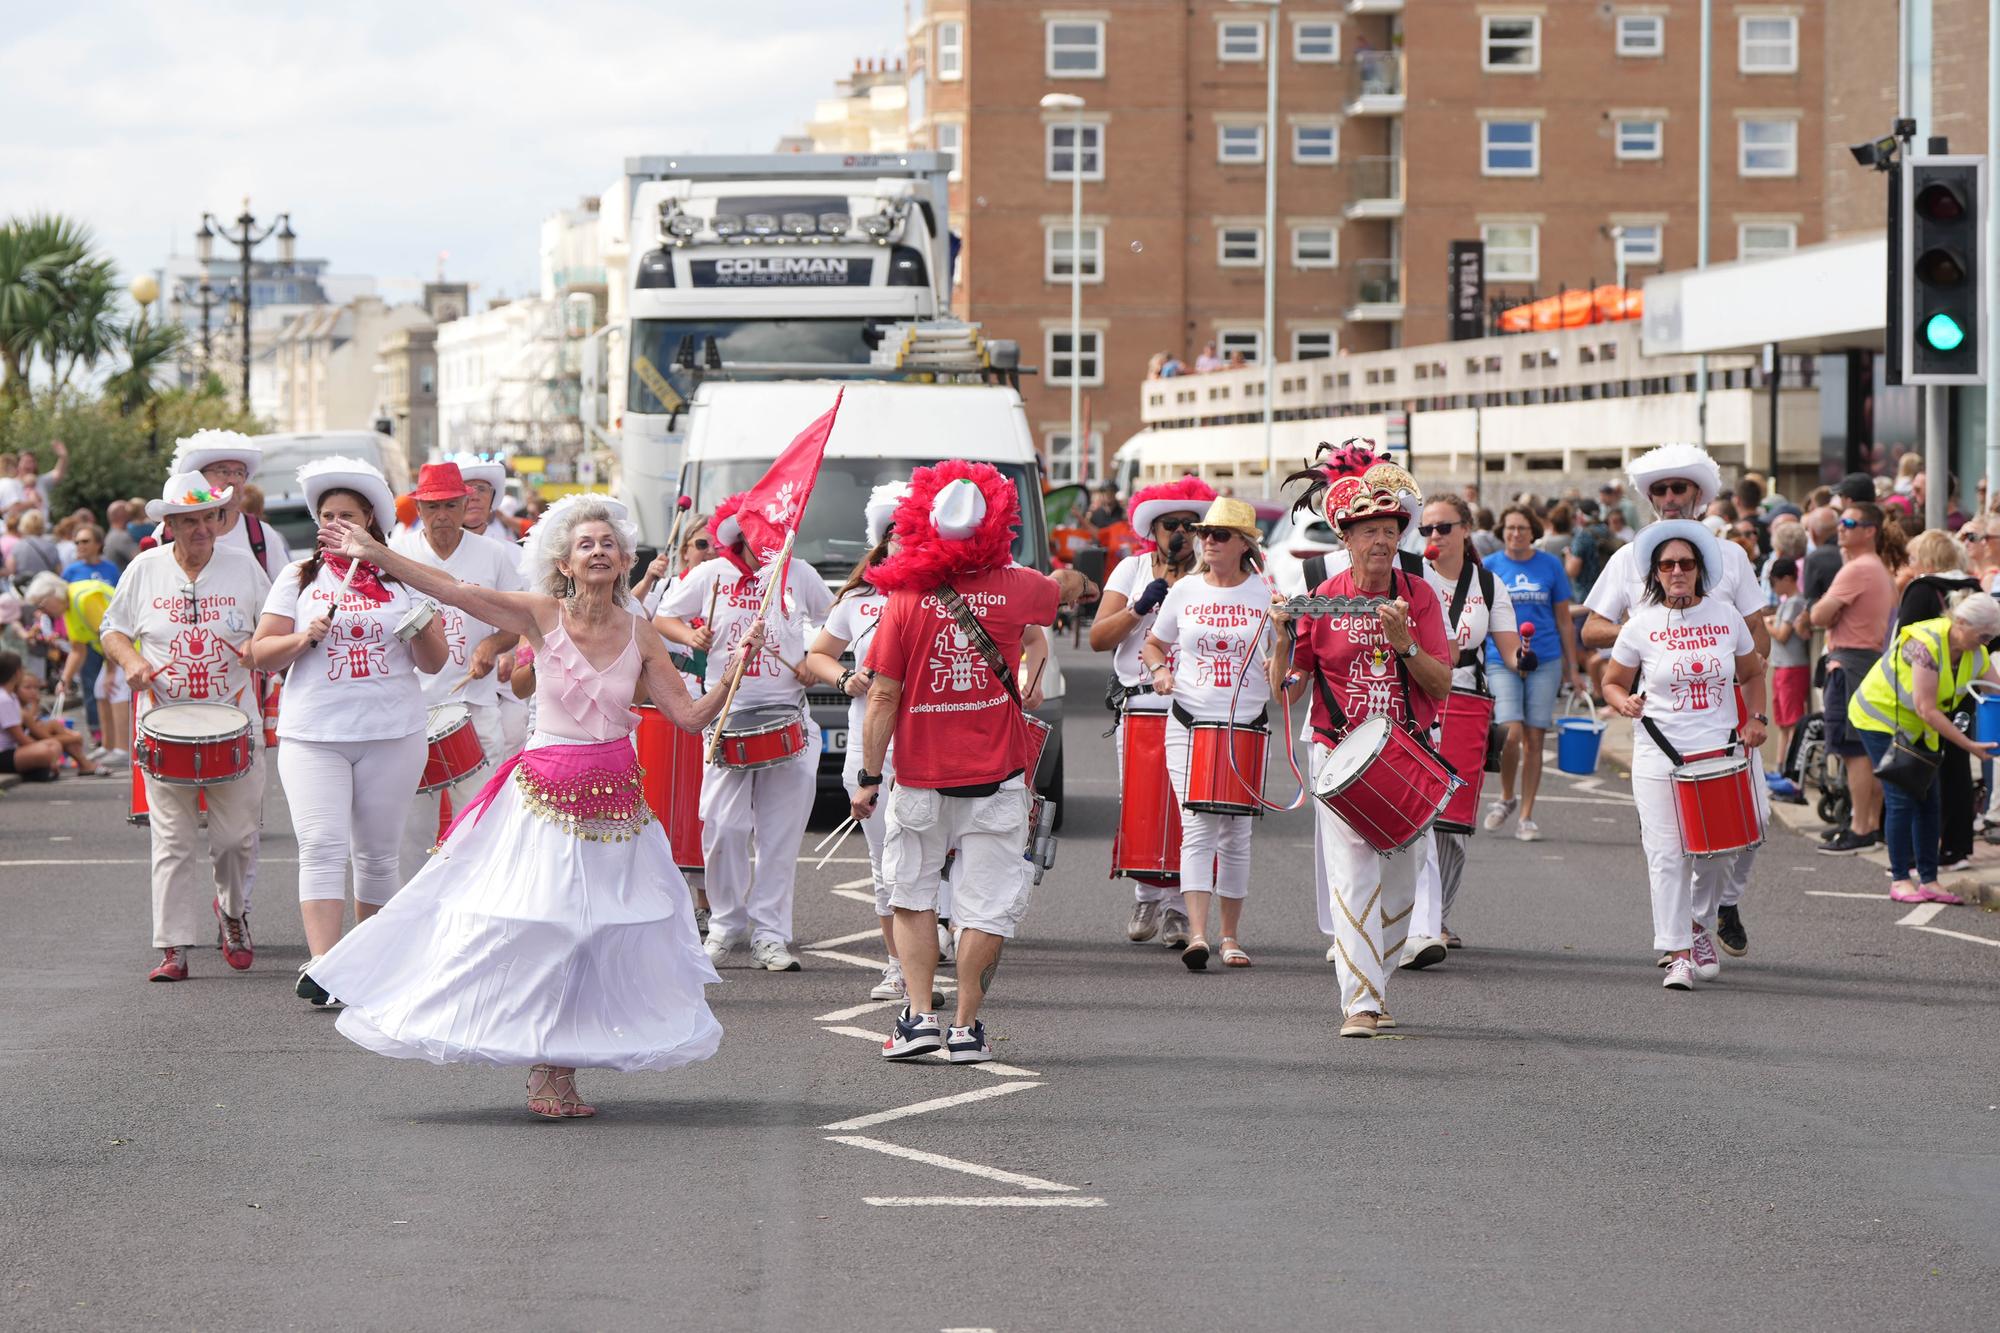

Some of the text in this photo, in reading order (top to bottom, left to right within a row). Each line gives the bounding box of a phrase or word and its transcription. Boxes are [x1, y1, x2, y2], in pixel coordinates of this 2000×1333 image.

[715, 258, 848, 274] COLEMAN
[716, 273, 848, 284] AND SON LIMITED
[1185, 603, 1262, 619] Celebration
[1196, 615, 1248, 628] Samba
[1650, 623, 1730, 642] Celebration
[1666, 636, 1717, 651] Samba
